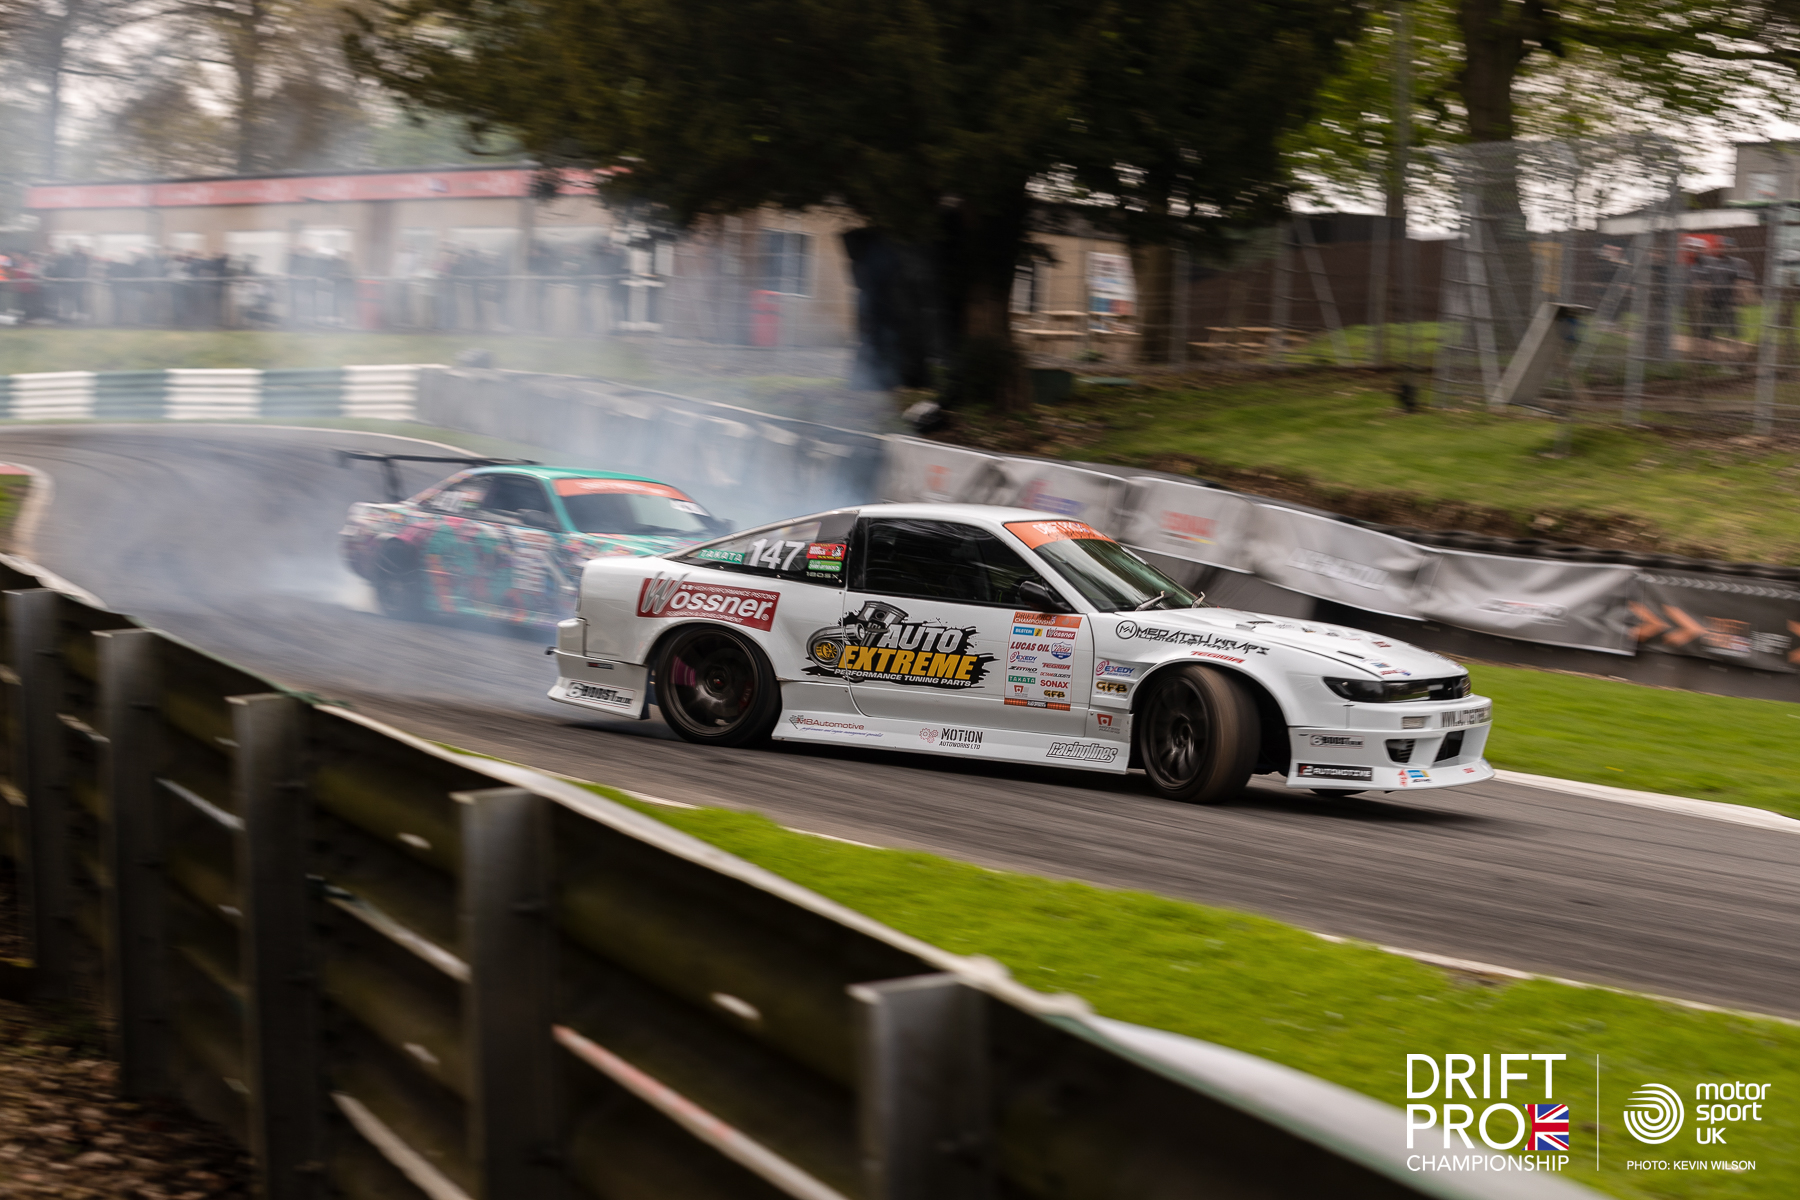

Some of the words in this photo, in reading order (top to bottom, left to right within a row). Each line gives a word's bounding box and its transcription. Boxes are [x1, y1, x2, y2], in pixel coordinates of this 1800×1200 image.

[700, 549, 744, 563] TAKATA
[752, 538, 806, 571] 147
[640, 571, 774, 620] Wossner
[877, 625, 963, 653] AUTO
[1010, 641, 1036, 651] LUCAS
[1037, 643, 1050, 652] OIL
[837, 645, 978, 680] EXTREME
[1104, 665, 1135, 674] EXEDY
[834, 668, 903, 681] PERFORMANCE
[904, 675, 939, 684] TUNING
[941, 678, 972, 687] PARTS
[1040, 680, 1069, 689] SONAX
[1043, 690, 1065, 698] GFB
[1096, 681, 1128, 693] GFB
[941, 728, 983, 743] MOTION
[939, 741, 970, 749] AUTOWORKS
[1046, 741, 1119, 764] racinglines
